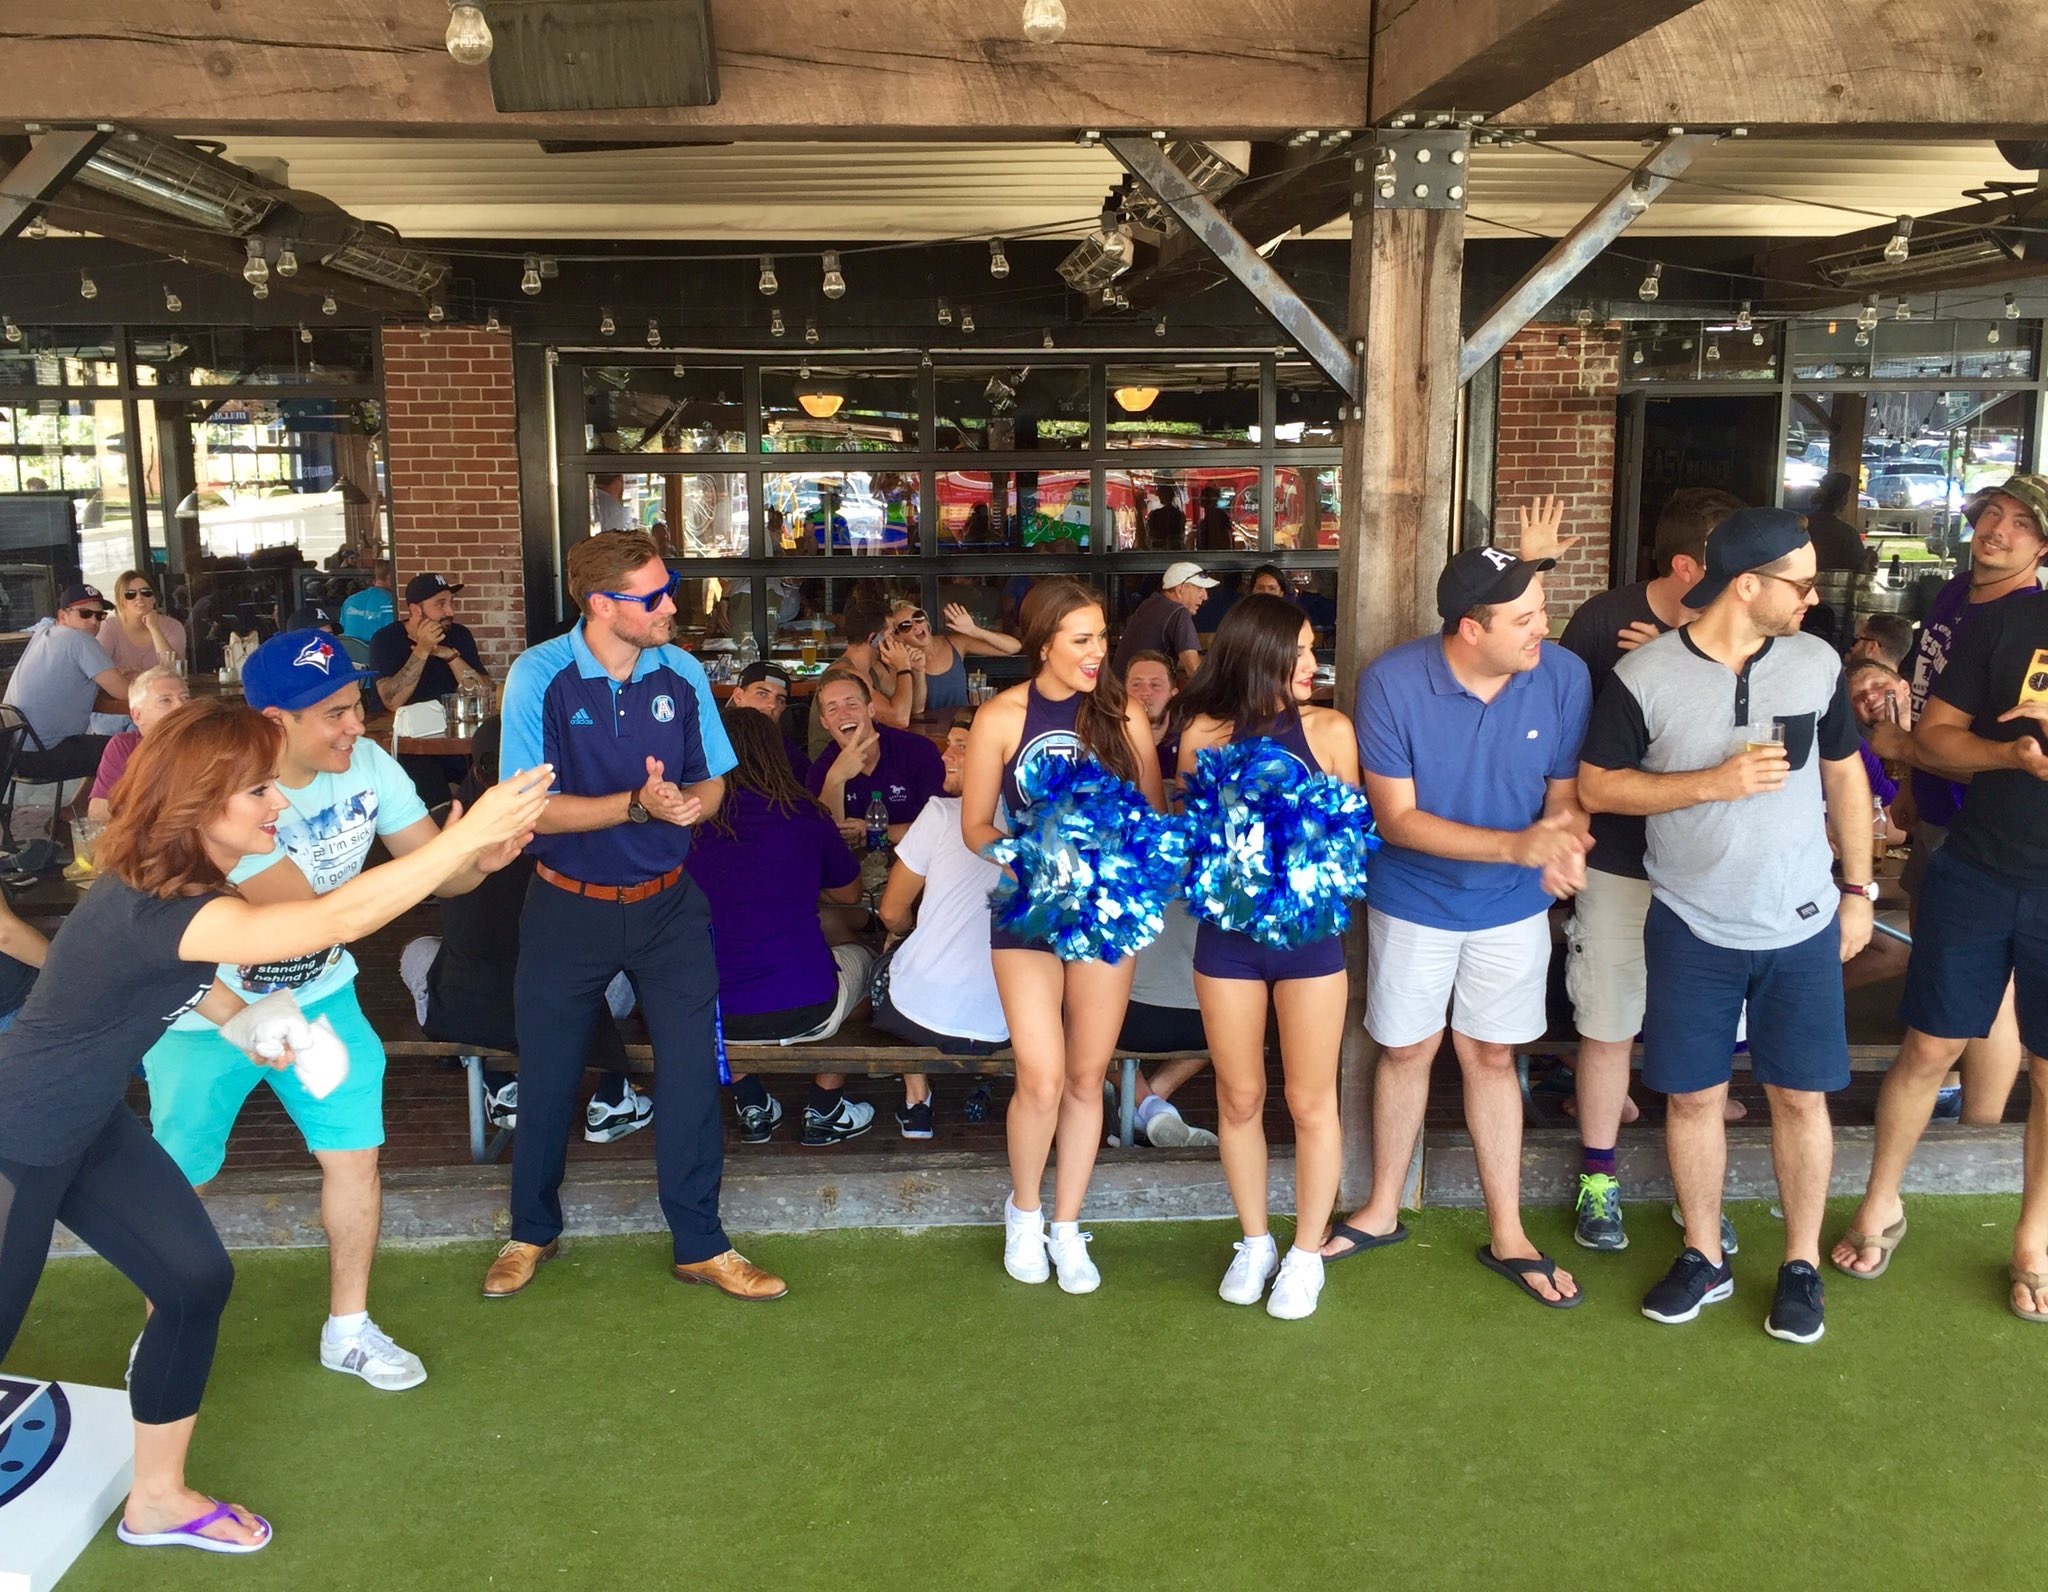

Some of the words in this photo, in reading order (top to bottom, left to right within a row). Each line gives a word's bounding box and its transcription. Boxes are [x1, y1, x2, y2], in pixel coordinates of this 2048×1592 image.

[1481, 547, 1517, 571] A
[315, 608, 330, 620] A
[656, 698, 673, 719] A
[328, 840, 347, 854] I'm
[351, 828, 370, 845] sick
[329, 861, 357, 885] going
[258, 959, 316, 973] standing
[254, 973, 302, 982] behind
